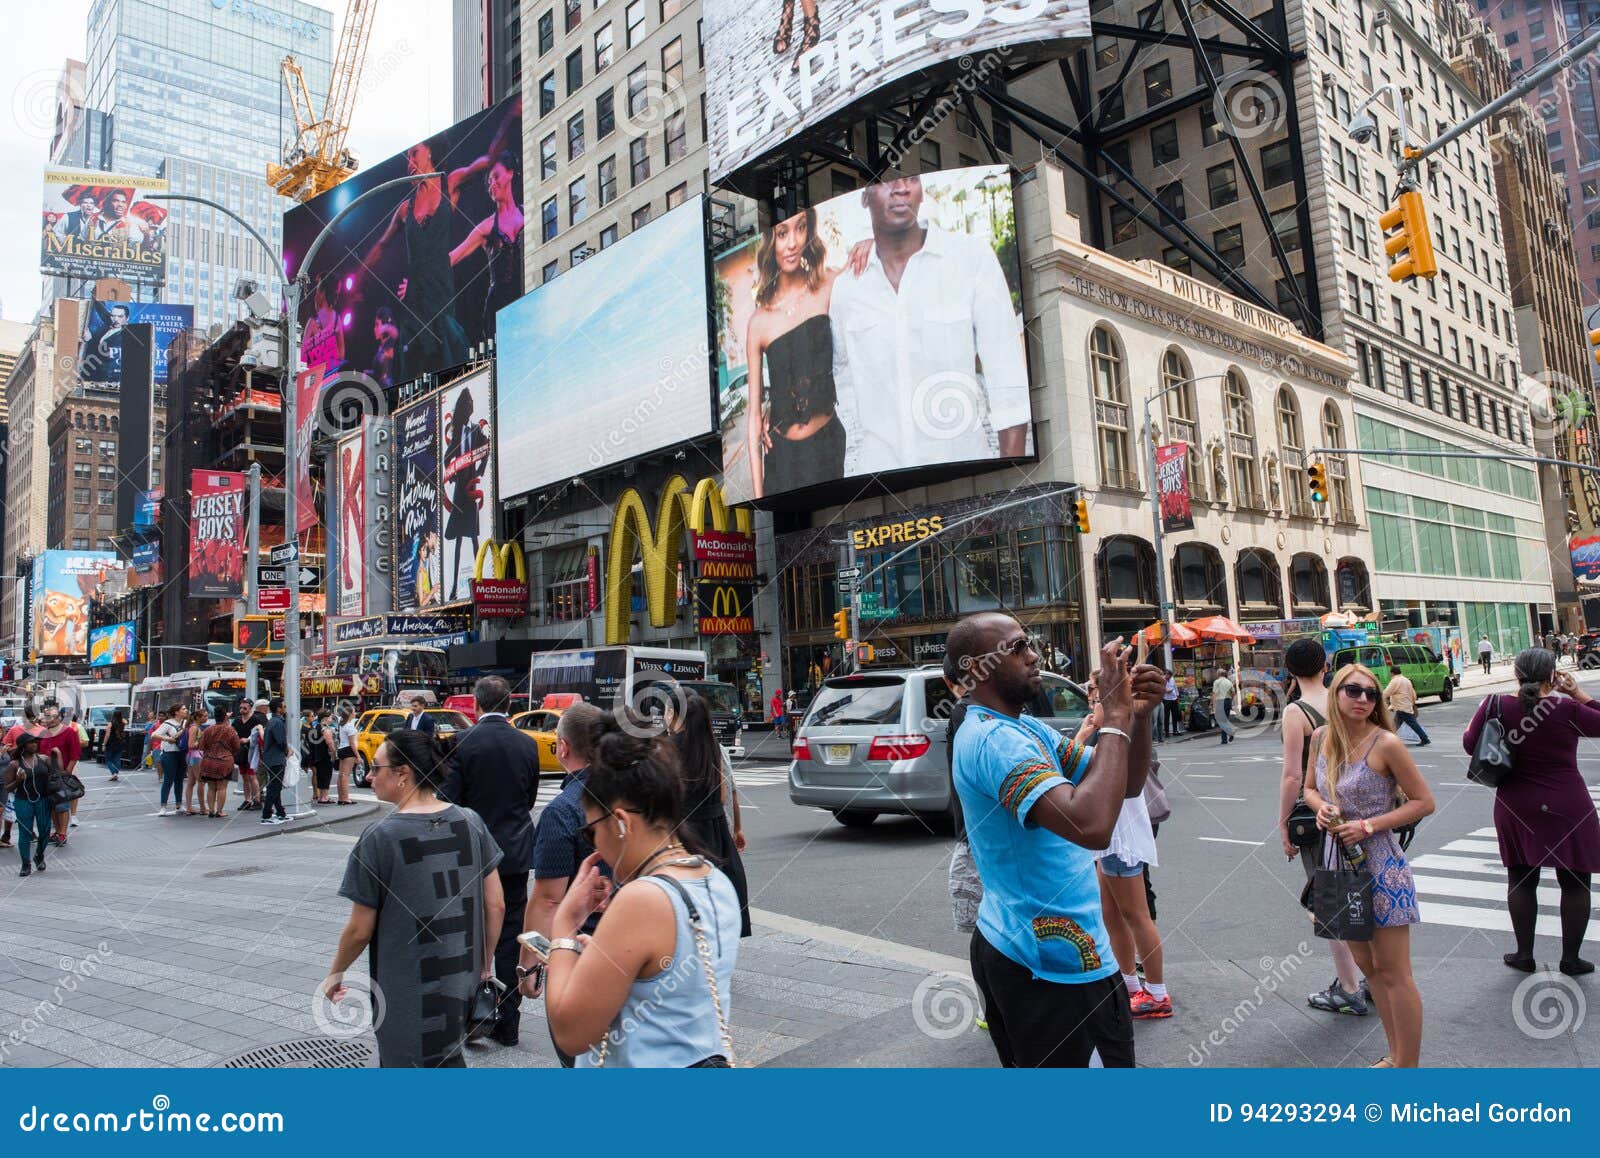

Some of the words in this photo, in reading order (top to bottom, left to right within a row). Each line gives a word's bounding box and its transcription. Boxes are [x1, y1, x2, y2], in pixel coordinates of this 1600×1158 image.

[89, 226, 118, 243] Les
[1074, 275, 1096, 298] THE
[1098, 285, 1129, 313] SHOW
[1172, 275, 1224, 313] MILLER
[1232, 300, 1287, 337] BUILDING
[1159, 456, 1185, 480] JERSEY
[1162, 474, 1182, 493] BOYS
[192, 493, 243, 518] JERSEY
[374, 428, 390, 572] PALACE
[198, 516, 234, 540] BOYS
[852, 515, 943, 550] EXPRESS
[696, 539, 754, 552] McDonald's
[264, 571, 281, 580] ONE
[476, 585, 528, 594] McDonald's
[453, 636, 465, 646] ATM
[914, 643, 947, 655] EXPRES
[873, 647, 897, 657] PRESS
[311, 679, 326, 696] NEW
[326, 678, 344, 695] YORK
